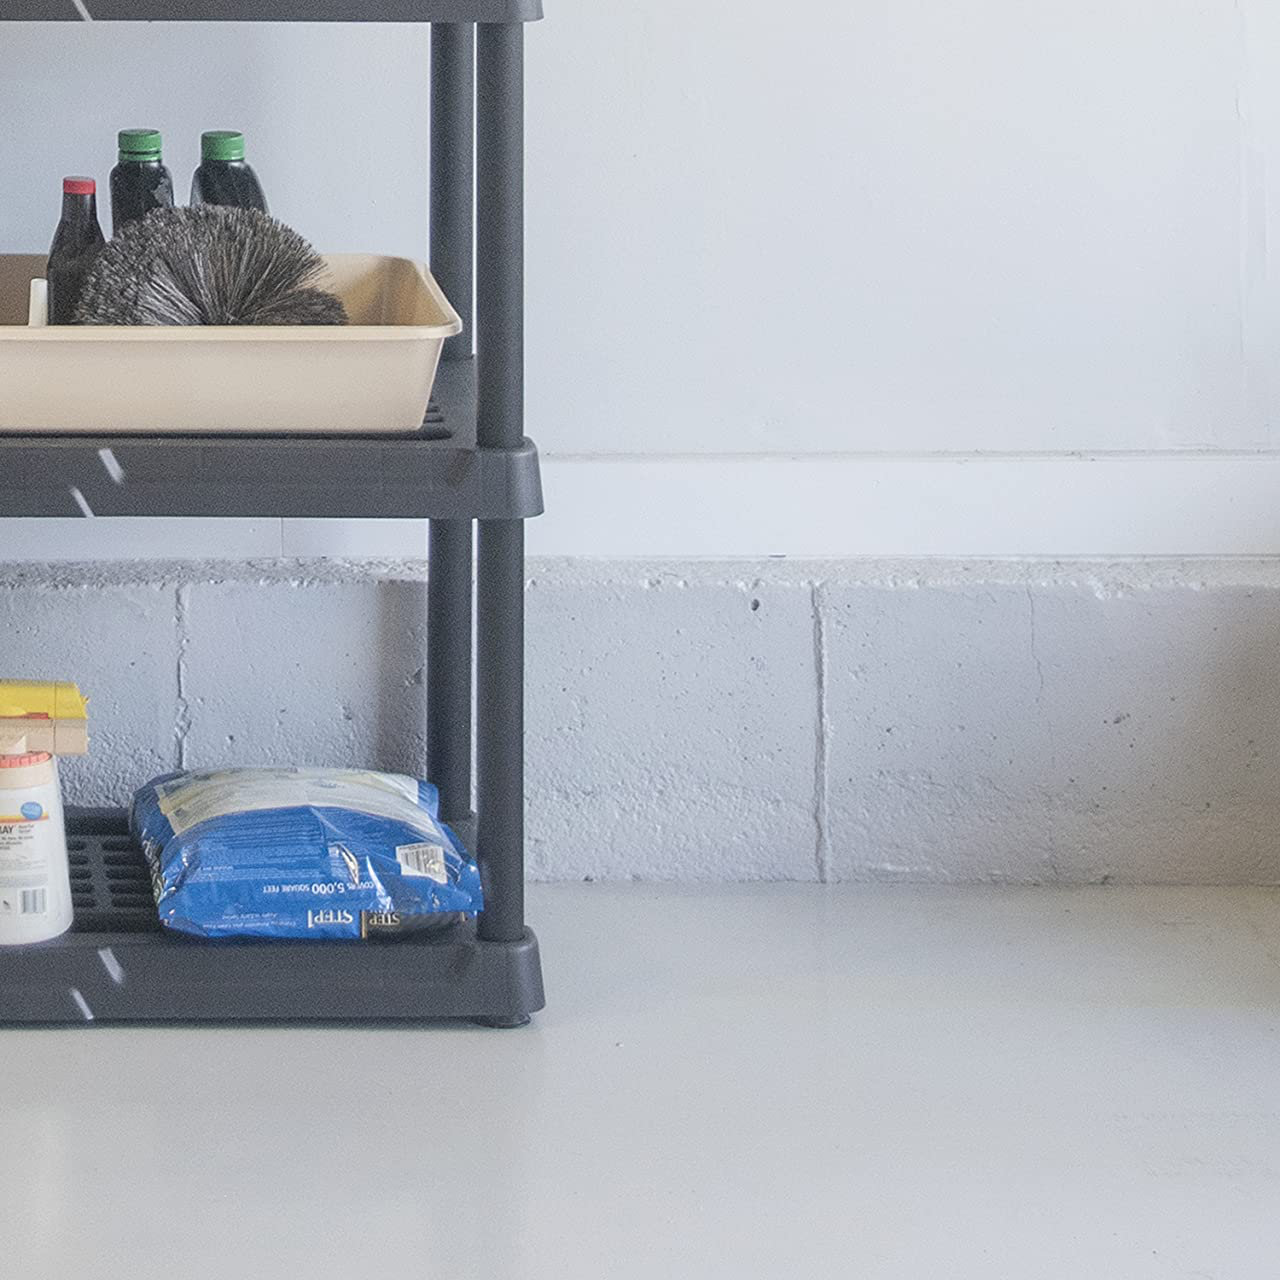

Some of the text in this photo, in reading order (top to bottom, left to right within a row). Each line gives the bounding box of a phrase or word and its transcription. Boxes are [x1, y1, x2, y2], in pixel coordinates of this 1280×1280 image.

[262, 884, 280, 894] FEET
[281, 883, 310, 893] SQUARE
[311, 882, 345, 894] 5,000
[369, 911, 400, 926] STEP
